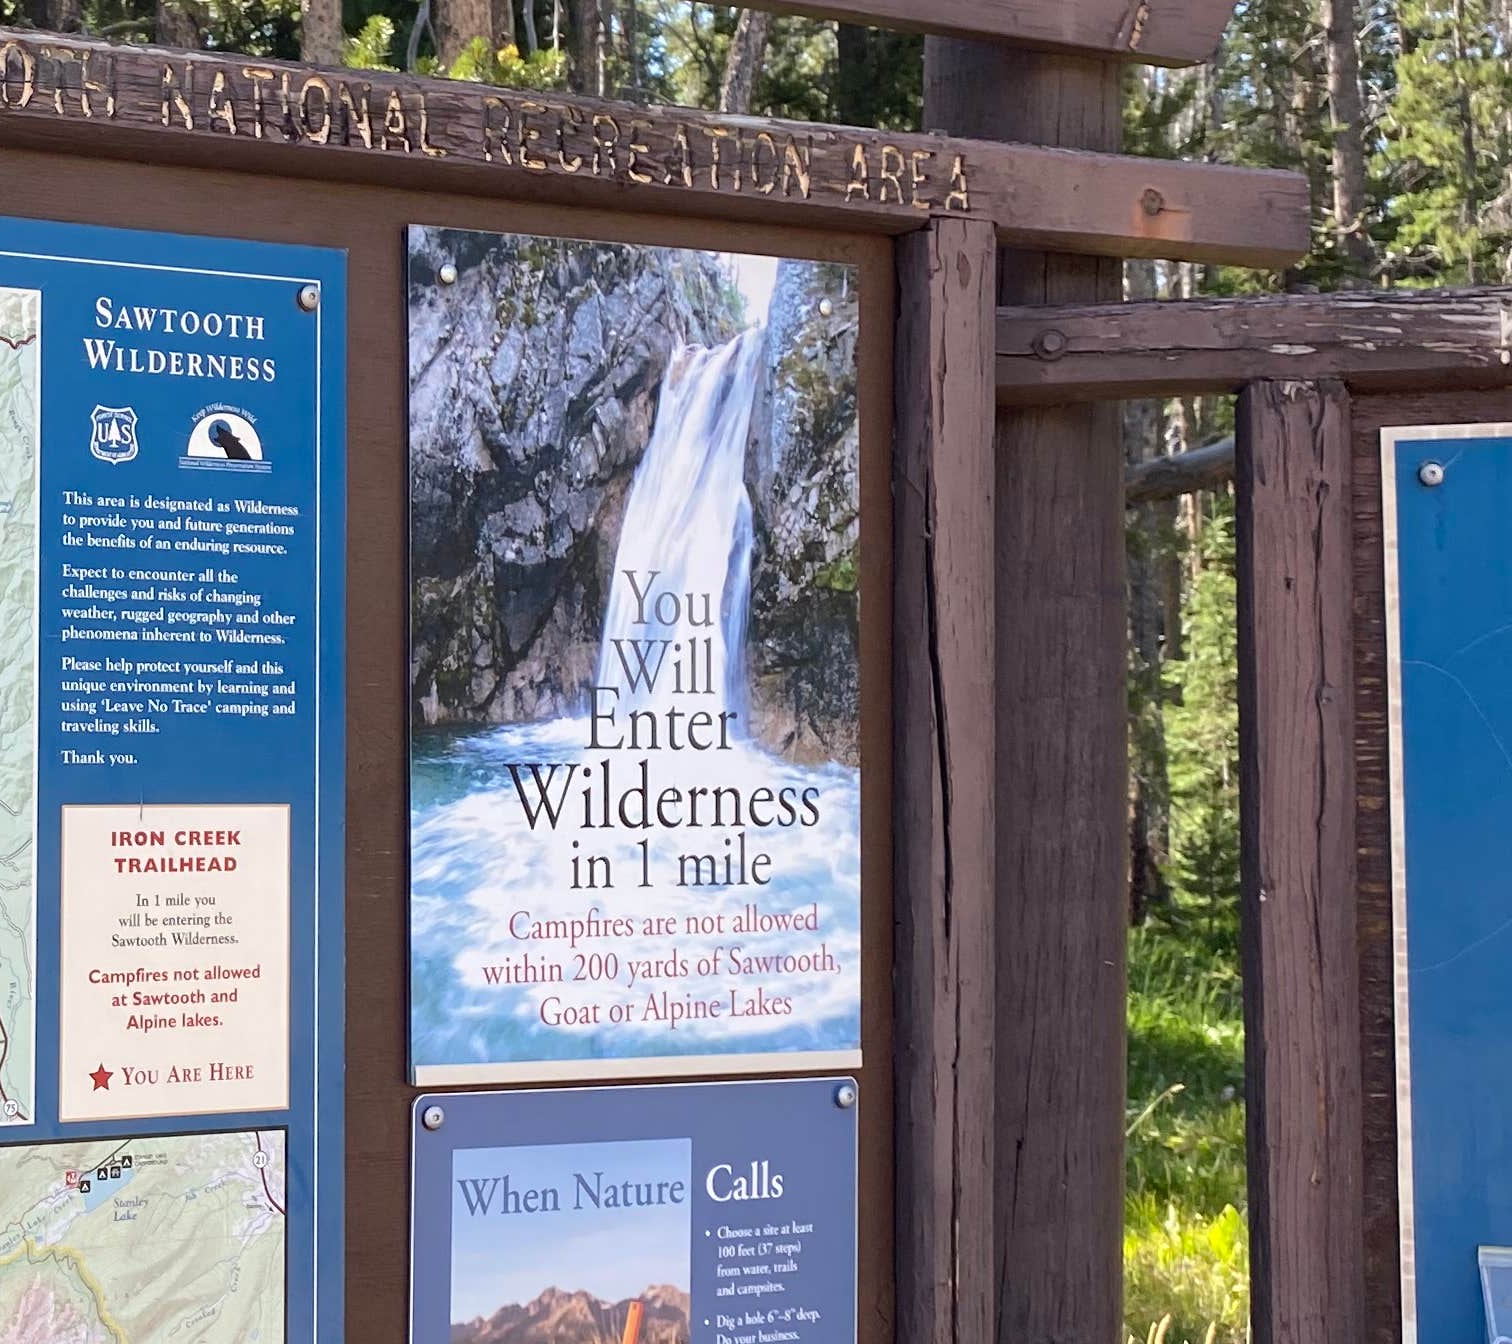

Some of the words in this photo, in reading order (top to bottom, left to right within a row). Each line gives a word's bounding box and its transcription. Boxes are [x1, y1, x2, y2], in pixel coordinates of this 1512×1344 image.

[162, 62, 447, 158] NATIONAL
[484, 97, 812, 199] RECREATION
[846, 143, 969, 213] AREA
[95, 296, 265, 340] SAWTOOTH
[84, 338, 276, 382] WILDERNESS
[63, 491, 92, 506] This
[97, 496, 124, 507] area
[131, 495, 139, 508] is
[145, 497, 212, 514] designated
[217, 502, 230, 512] as
[234, 499, 298, 516] Wilderness
[63, 514, 75, 525] to
[80, 514, 127, 529] provide
[131, 519, 154, 530] you
[158, 517, 181, 530] and
[185, 518, 223, 531] future
[226, 522, 294, 536] generations
[63, 534, 83, 547] the
[87, 534, 135, 548] benefits
[140, 536, 152, 549] of
[156, 539, 171, 550] an
[175, 538, 229, 554] enduring
[233, 542, 287, 554] resource.
[63, 564, 107, 581] Expect
[112, 568, 124, 579] to
[129, 569, 194, 582] encounter
[199, 569, 213, 583] all
[218, 570, 238, 583] the
[62, 585, 127, 601] challenges
[131, 587, 154, 600] and
[159, 587, 186, 601] risks
[190, 588, 205, 601] of
[206, 589, 261, 605] changing
[622, 570, 715, 627] You
[62, 606, 117, 621] weather,
[122, 608, 163, 623] rugged
[168, 611, 231, 625] geography
[236, 611, 258, 624] and
[263, 612, 295, 625] other
[62, 627, 138, 642] phenomena
[142, 628, 195, 642] inherent
[200, 631, 212, 642] to
[216, 629, 285, 645] Wilderness.
[62, 657, 101, 671] Please
[106, 658, 132, 674] help
[137, 662, 180, 675] protect
[184, 660, 233, 676] yourself
[236, 661, 258, 674] and
[262, 661, 284, 674] this
[611, 638, 715, 695] Will
[62, 680, 106, 694] unique
[110, 681, 193, 693] environment
[197, 679, 213, 696] by
[217, 680, 268, 696] learning
[272, 681, 295, 694] and
[61, 700, 96, 714] using
[148, 701, 168, 713] No
[216, 702, 268, 716] camping
[272, 701, 295, 714] and
[61, 720, 119, 735] traveling
[123, 720, 159, 733] skills.
[585, 686, 737, 751] Enter
[61, 750, 104, 764] Thank
[110, 753, 138, 766] you.
[504, 759, 821, 831] Wilderness
[111, 831, 165, 847] IRON
[175, 830, 241, 846] CREEK
[114, 857, 237, 874] TRAILHEAD
[570, 841, 614, 890] in
[637, 839, 654, 888] 1
[677, 832, 772, 888] mile
[136, 894, 149, 907] In
[154, 894, 160, 907] 1
[166, 893, 190, 907] mile
[195, 895, 216, 909] you
[118, 914, 140, 928] will
[145, 914, 158, 927] be
[163, 915, 210, 929] entering
[214, 913, 233, 926] the
[509, 908, 634, 948] Campfires
[642, 917, 674, 936] are
[686, 912, 725, 935] not
[732, 903, 818, 933] allowed
[112, 933, 167, 948] Sawtooth
[172, 933, 239, 946] Wilderness.
[88, 968, 168, 987] Campfires
[173, 969, 198, 982] not
[204, 964, 260, 981] allowed
[482, 958, 563, 986] within
[573, 953, 618, 982] 200
[627, 952, 688, 987] yards
[697, 948, 724, 977] of
[728, 944, 842, 977] Sawtooth,
[112, 994, 126, 1007] at
[132, 991, 205, 1006] Sawtooth
[211, 988, 237, 1003] and
[540, 996, 600, 1027] Goat
[609, 1004, 634, 1023] or
[641, 993, 721, 1030] Alpine
[728, 990, 792, 1019] Lakes
[126, 1015, 176, 1033] Alpine
[182, 1013, 223, 1028] lakes.
[122, 1067, 159, 1086] YOU
[166, 1065, 201, 1084] ARE
[210, 1063, 254, 1082] HERE
[6, 1103, 16, 1112] 75
[255, 1156, 265, 1165] 21
[457, 1175, 560, 1217] When
[573, 1172, 685, 1211] Nature
[705, 1159, 785, 1203] Calls
[718, 1226, 752, 1239] Choose
[763, 1224, 778, 1236] site
[781, 1226, 790, 1234] at
[792, 1222, 813, 1234] least
[718, 1246, 735, 1258] 100
[738, 1243, 755, 1256] feet
[758, 1242, 773, 1256] (37
[776, 1240, 801, 1256] steps)
